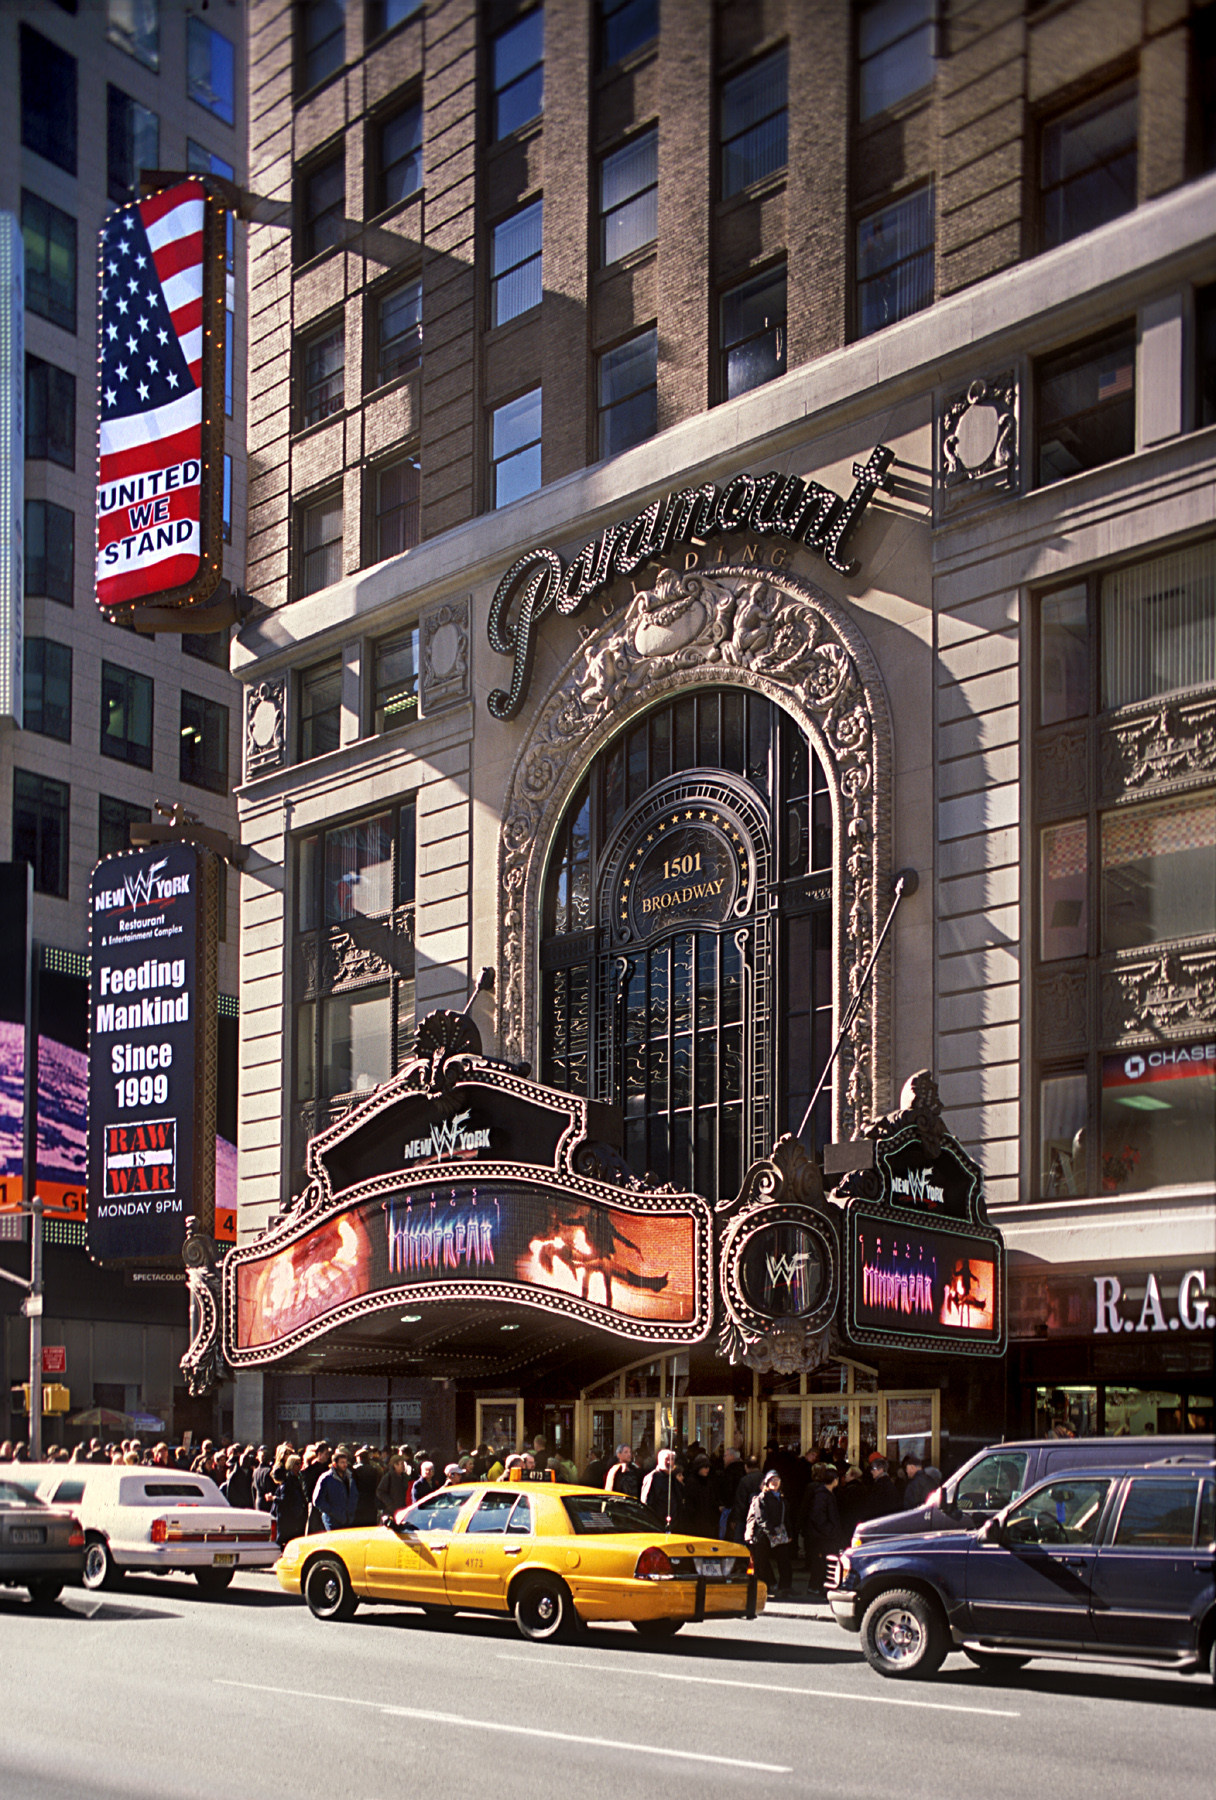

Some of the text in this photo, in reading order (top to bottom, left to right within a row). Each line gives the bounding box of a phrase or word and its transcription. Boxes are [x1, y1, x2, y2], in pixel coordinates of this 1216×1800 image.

[100, 460, 200, 511] UNITED
[128, 496, 170, 532] WE
[104, 519, 193, 565] STAND
[487, 443, 896, 722] Paramount
[577, 545, 787, 641] BUIDING
[663, 851, 702, 880] 1501
[95, 887, 126, 912] NEW
[156, 874, 190, 899] YORK
[642, 878, 725, 913] BROADWAY
[108, 930, 153, 945] Entertainment
[154, 924, 183, 937] Complex
[119, 914, 165, 932] Restaurant
[100, 959, 186, 996] Feeding
[96, 992, 190, 1034] Mankind
[111, 1043, 173, 1074] Since
[1148, 1043, 1216, 1067] CHASE
[115, 1074, 169, 1108] 1999
[109, 1124, 171, 1153] RAW
[404, 1138, 432, 1159] NEW
[459, 1128, 491, 1150] YORK
[132, 1153, 147, 1167] IS
[109, 1166, 171, 1194] WAR
[892, 1177, 909, 1196] NEW
[926, 1184, 944, 1203] YORK
[97, 1199, 183, 1218] MONDAY 9PM
[387, 1216, 495, 1274] MINDFREAK
[132, 1273, 187, 1282] SPECTACOLOR
[863, 1262, 934, 1315] MINDFREAK
[1093, 1270, 1216, 1334] R.A.G.
